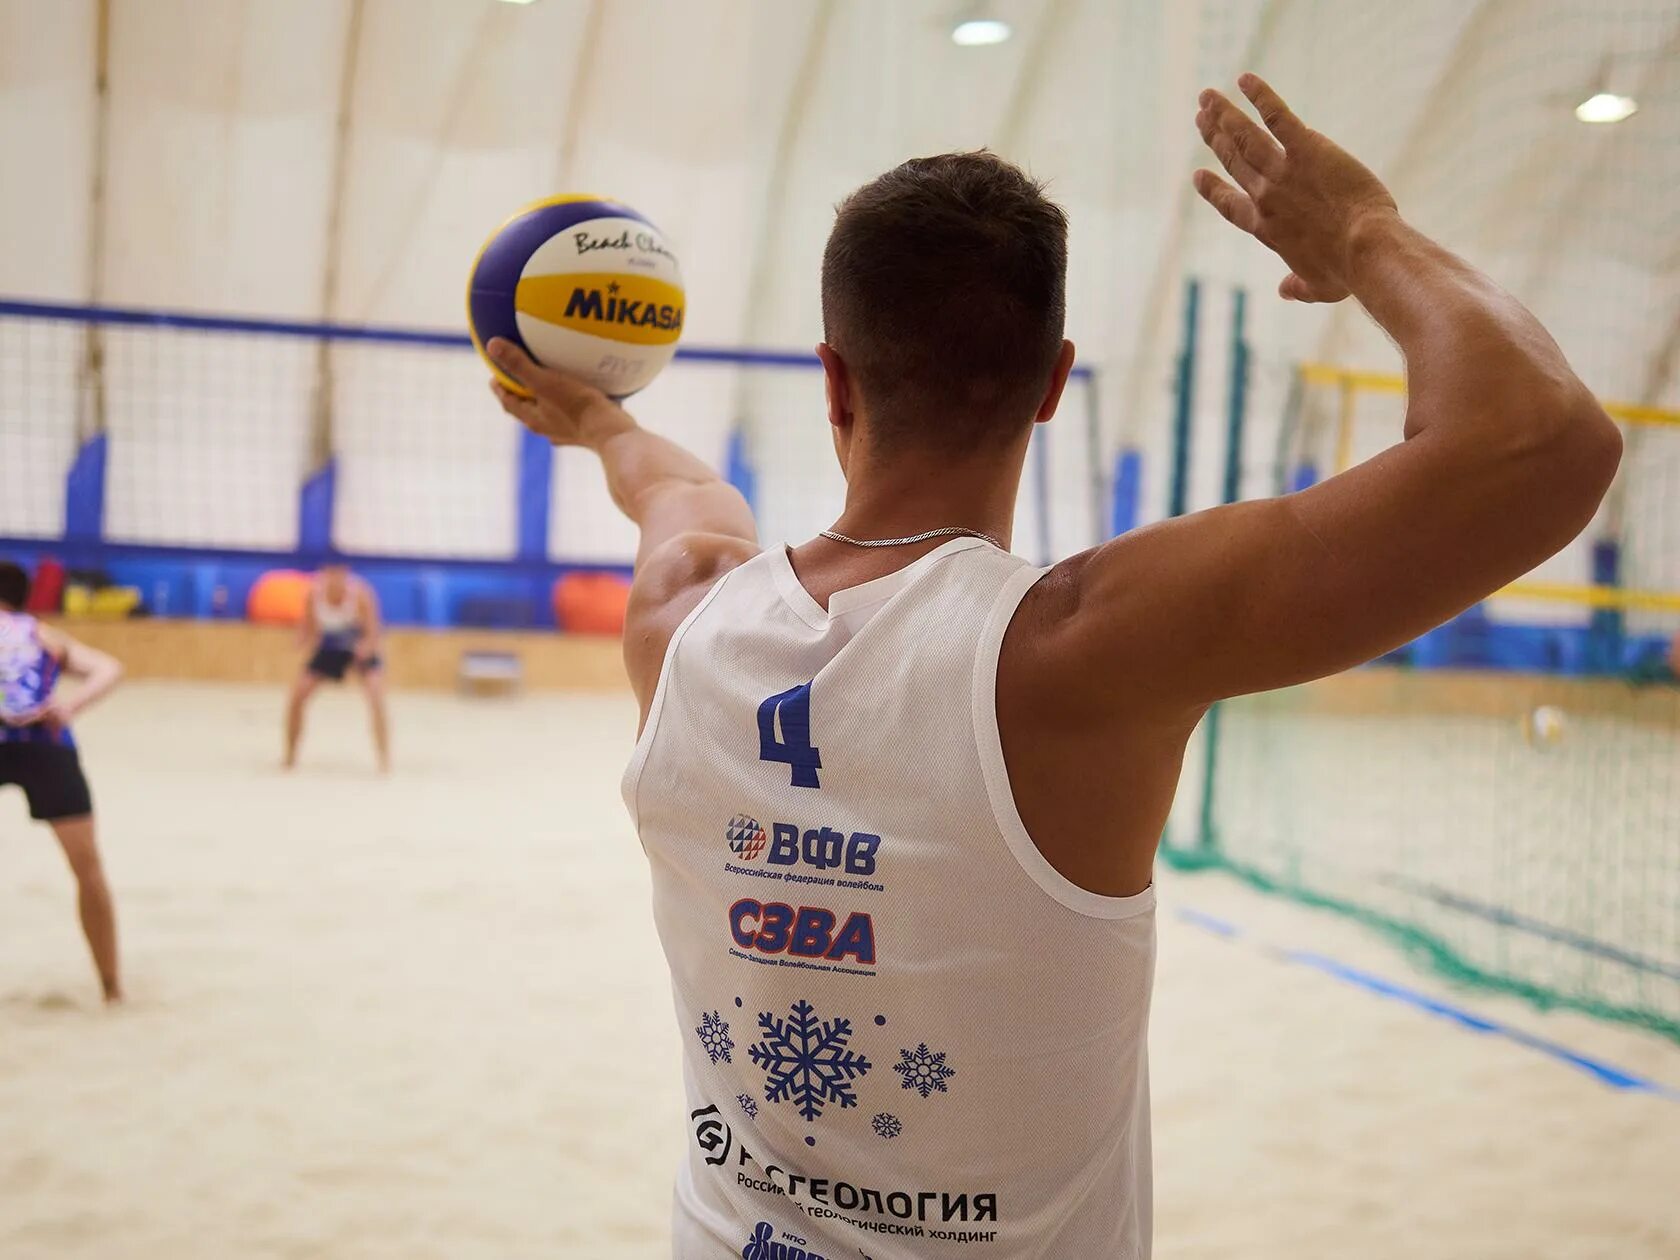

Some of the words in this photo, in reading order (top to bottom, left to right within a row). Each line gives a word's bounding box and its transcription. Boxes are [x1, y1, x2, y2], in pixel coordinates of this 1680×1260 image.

[574, 230, 632, 256] Beach
[757, 678, 823, 789] 4
[767, 822, 881, 876] ВФВ
[724, 862, 783, 881] Всероссийская
[783, 872, 835, 887] федерация
[836, 879, 884, 892] волейбола
[832, 965, 876, 977] Ассоциация
[808, 1204, 925, 1237] геологический
[928, 1229, 998, 1244] холдинг
